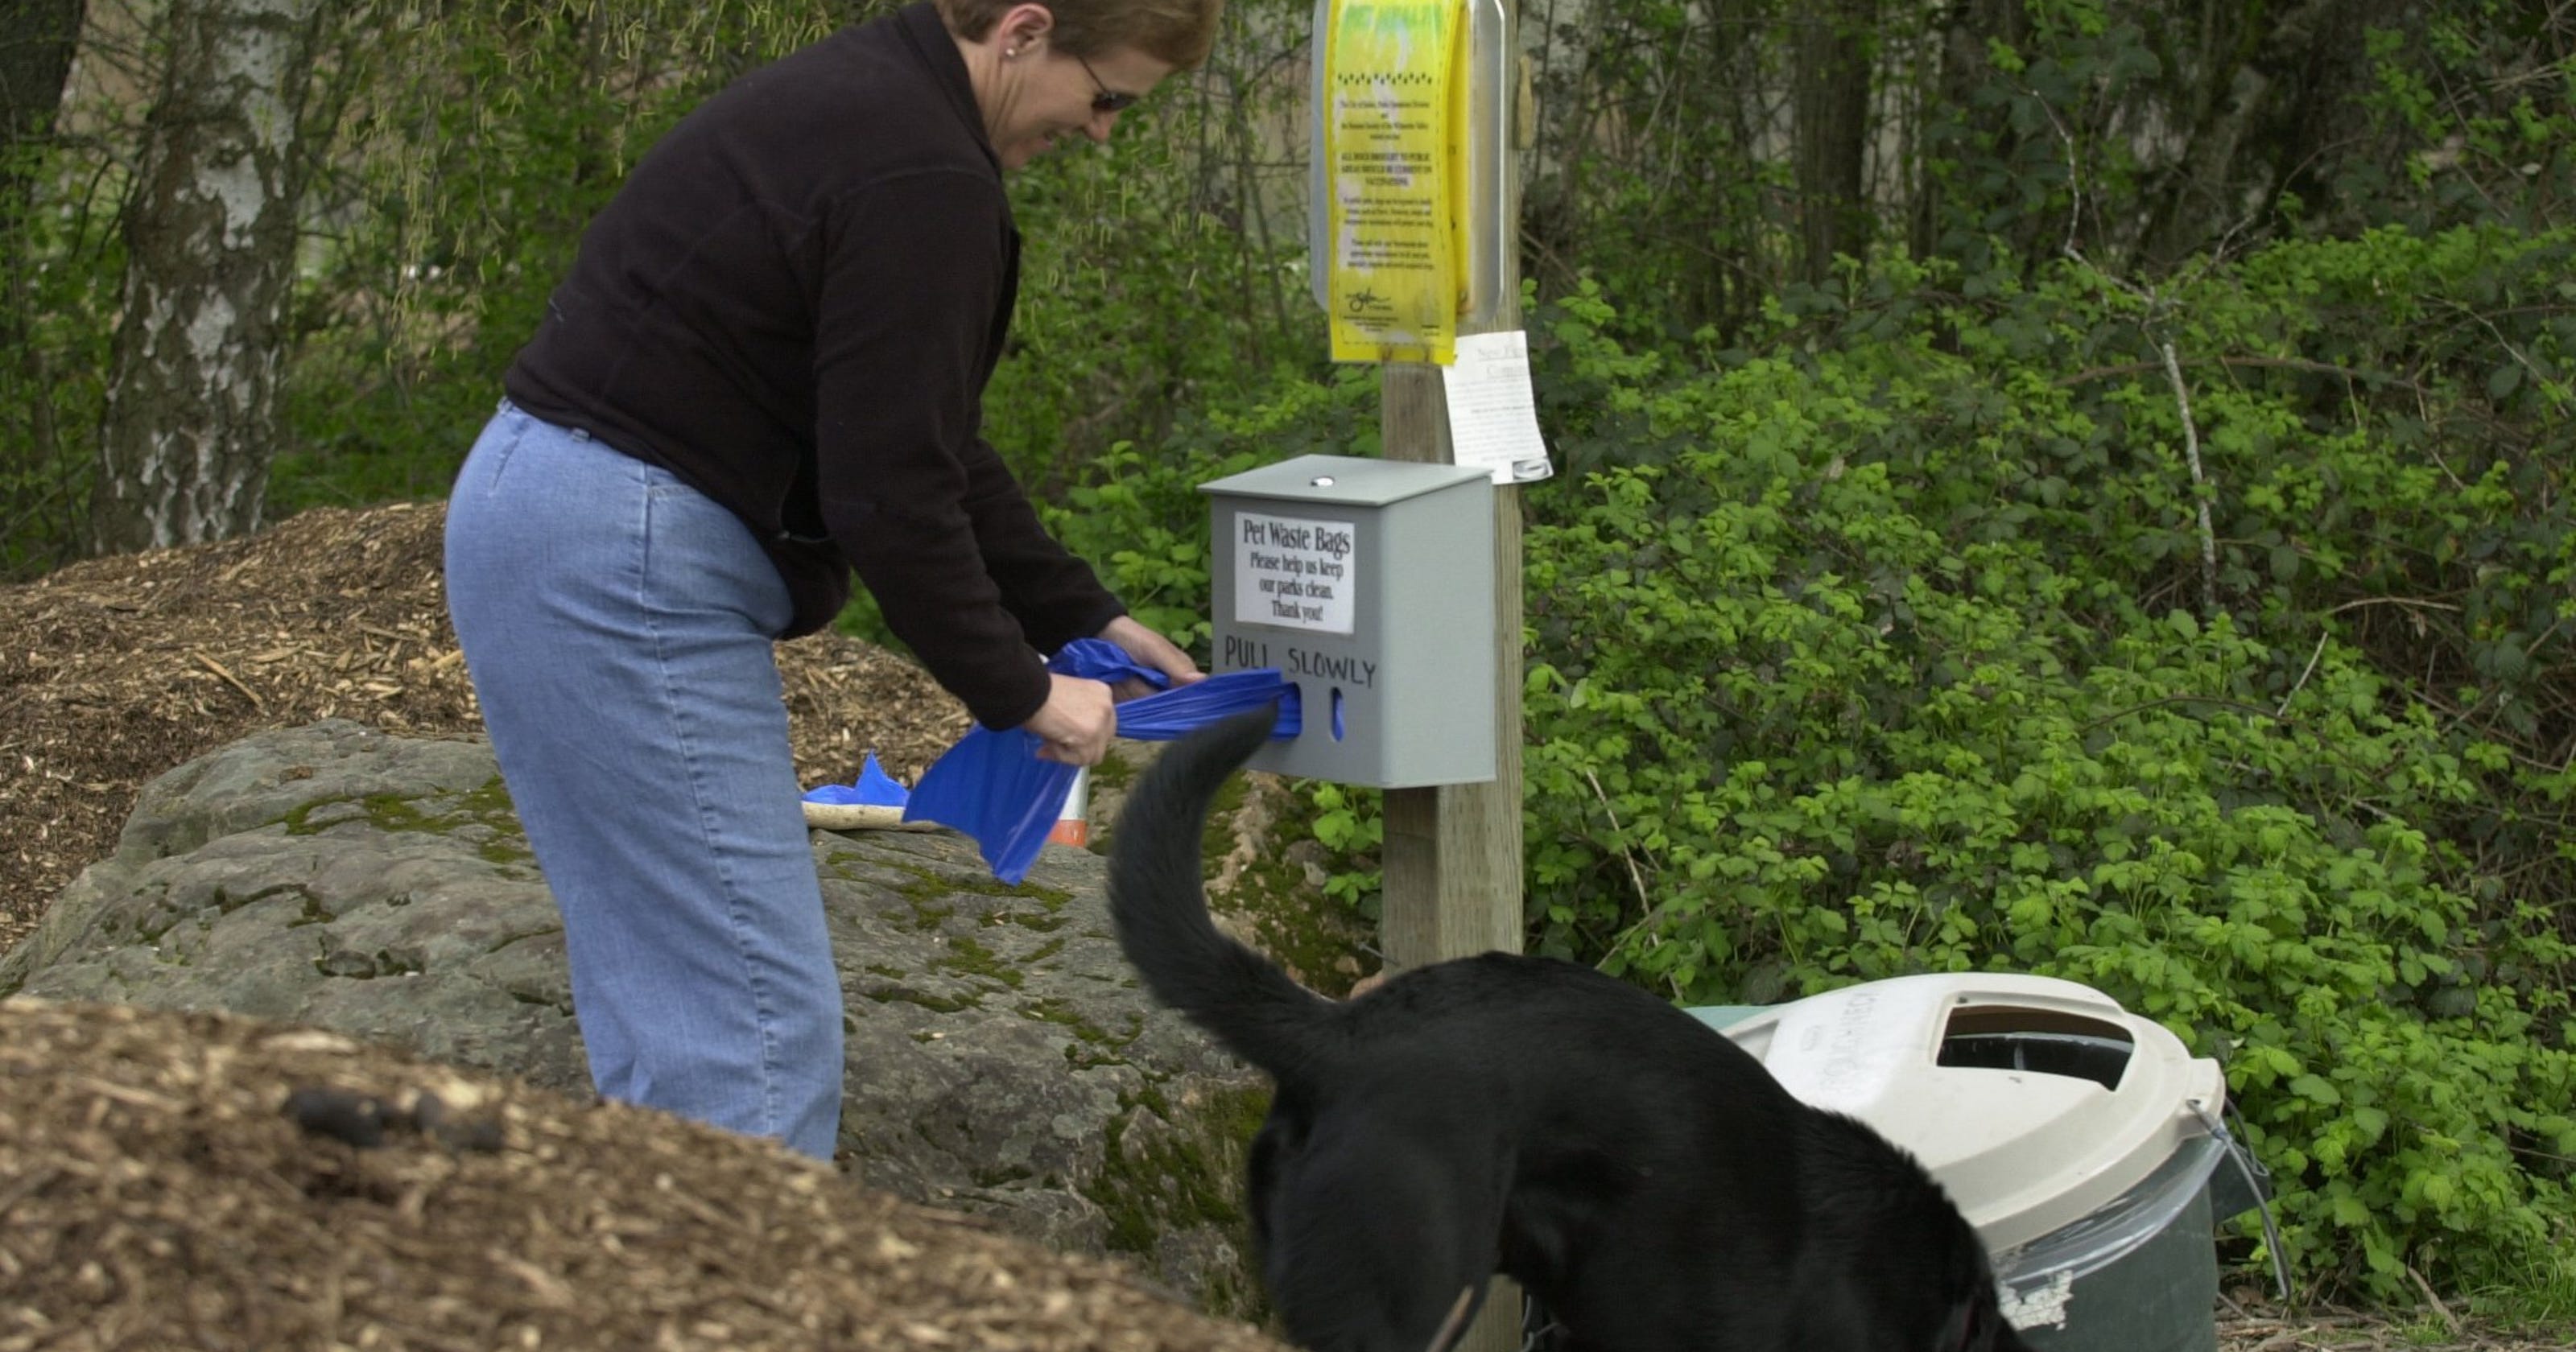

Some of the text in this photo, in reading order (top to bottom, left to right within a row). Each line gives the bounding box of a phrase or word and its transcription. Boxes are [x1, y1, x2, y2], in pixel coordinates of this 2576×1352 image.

[1244, 520, 1351, 561] Pet Waste Bags
[1251, 552, 1344, 581] Please help us keep
[1259, 578, 1334, 599] our parks clean.
[1272, 600, 1323, 624] Thank you!
[1288, 648, 1377, 689] SLOWLY
